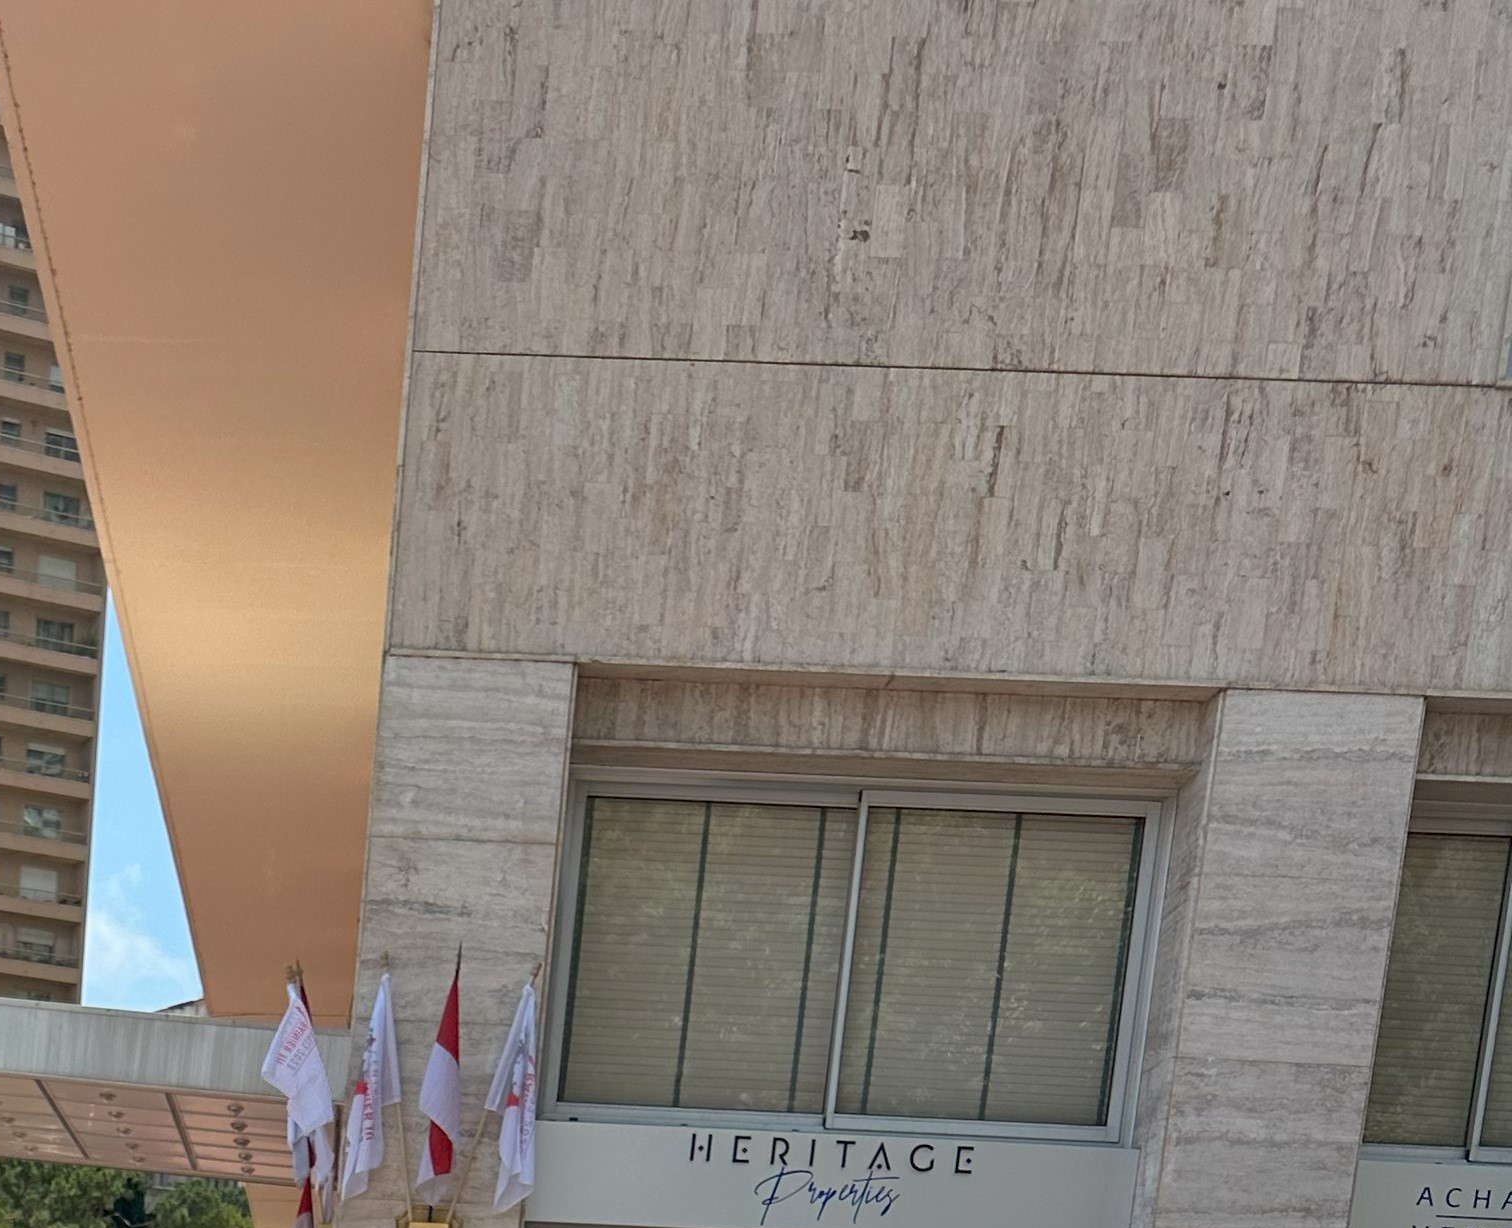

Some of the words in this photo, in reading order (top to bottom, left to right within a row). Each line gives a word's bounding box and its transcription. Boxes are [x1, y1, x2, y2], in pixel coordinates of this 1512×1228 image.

[689, 1133, 975, 1175] HERITAGE
[753, 1166, 901, 1226] Properties
[1416, 1186, 1512, 1210] ACHA
